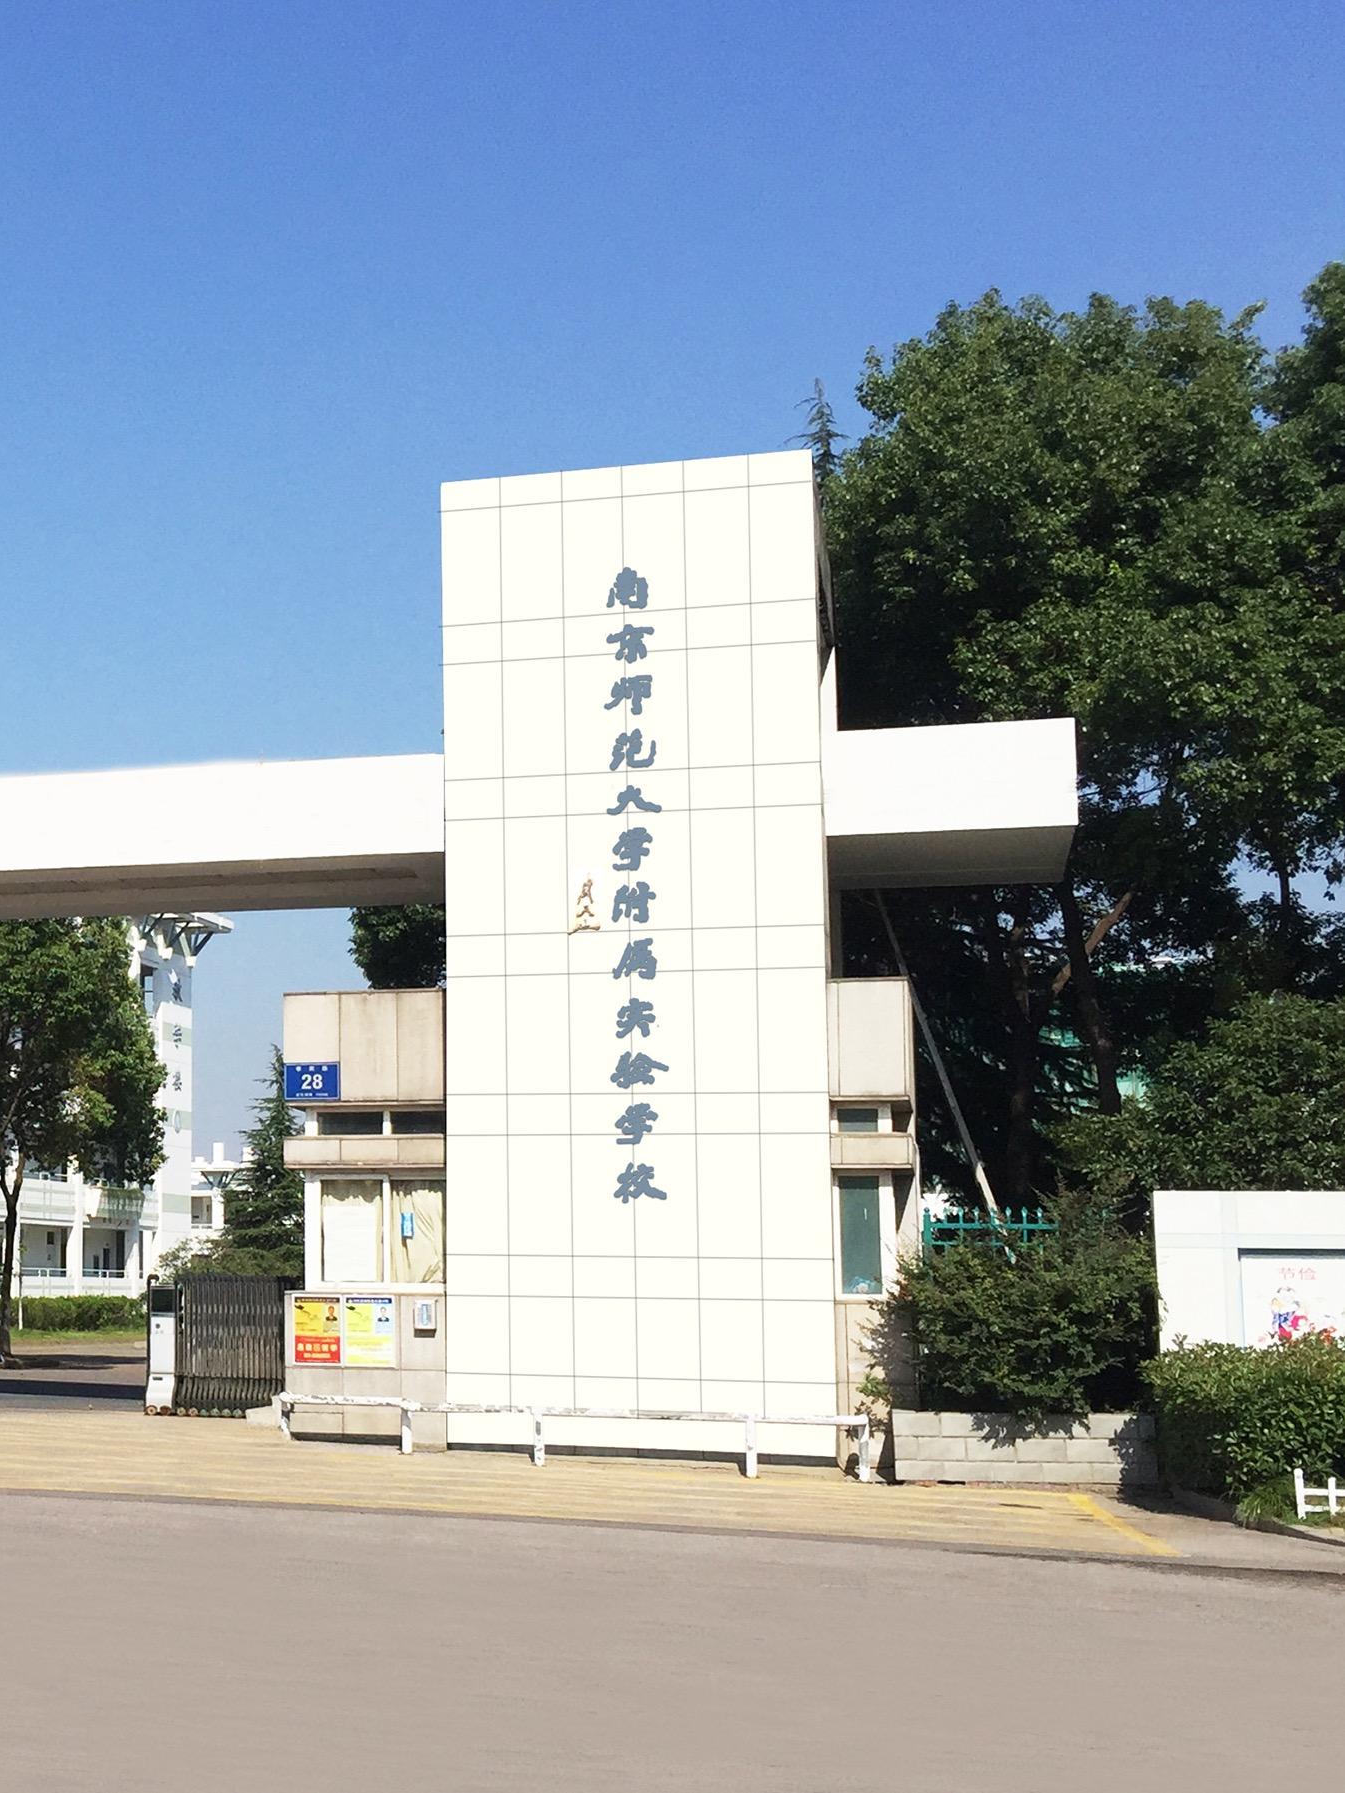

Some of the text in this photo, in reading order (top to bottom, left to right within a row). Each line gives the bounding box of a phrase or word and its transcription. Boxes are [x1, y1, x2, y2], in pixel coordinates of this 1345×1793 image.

[605, 567, 669, 1203] 南京师范大学附属实验学校
[301, 1074, 323, 1090] 28
